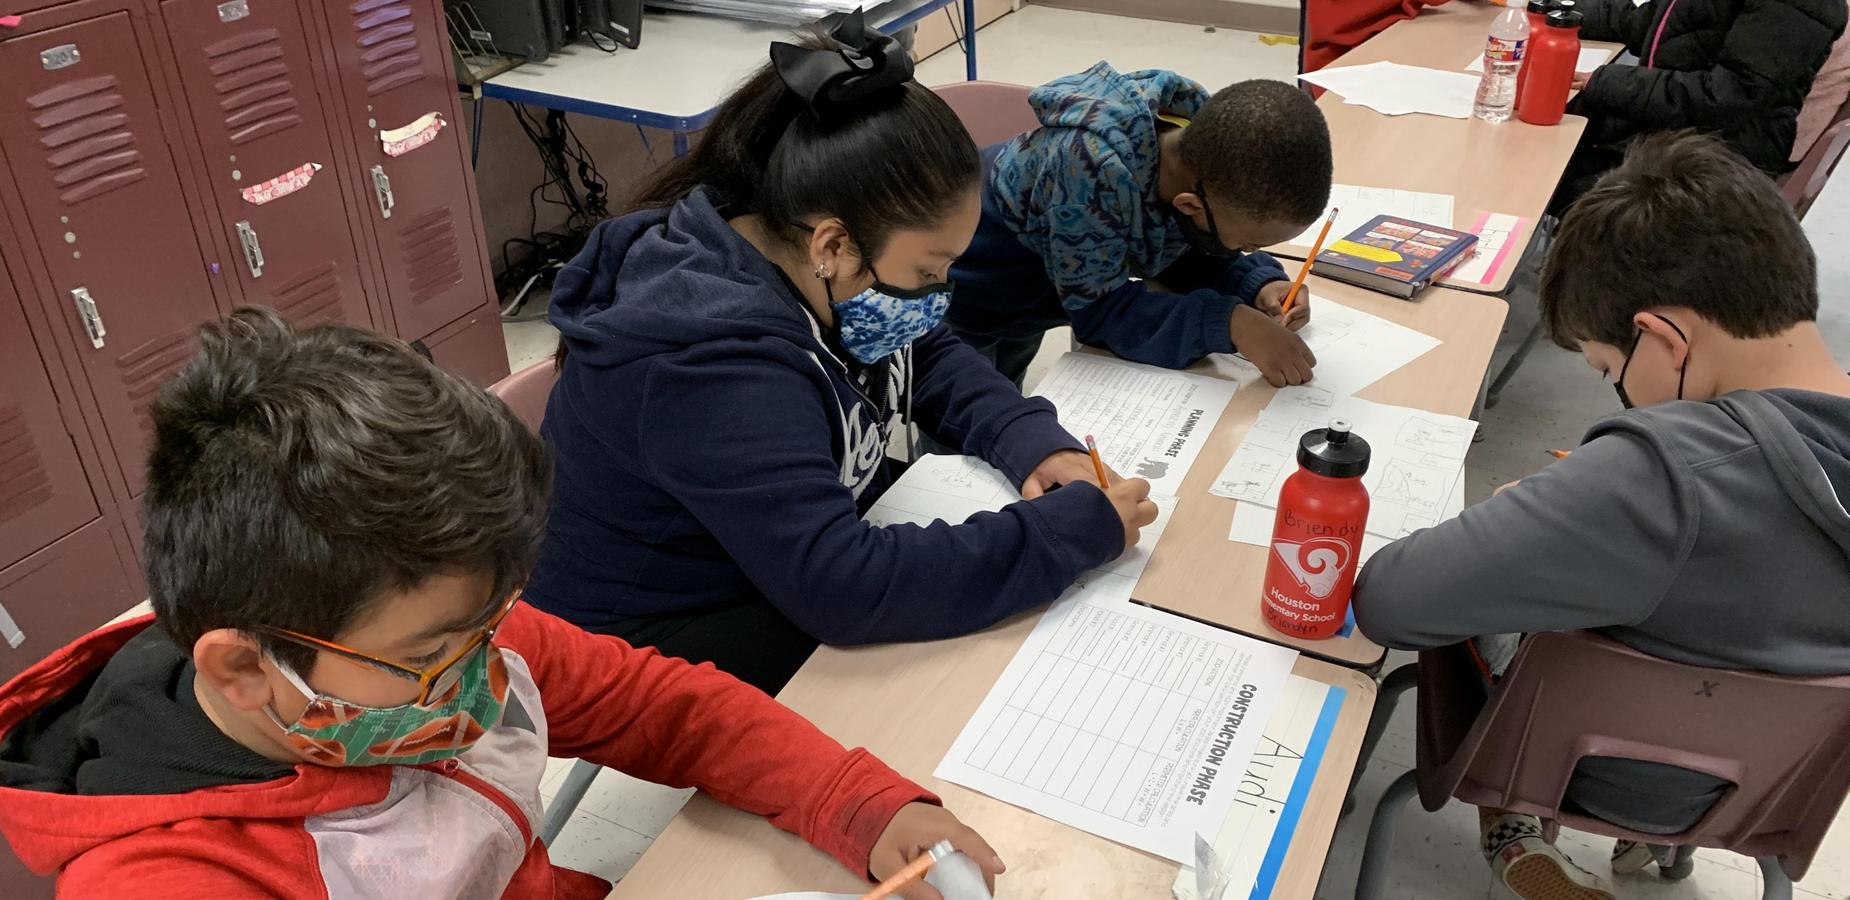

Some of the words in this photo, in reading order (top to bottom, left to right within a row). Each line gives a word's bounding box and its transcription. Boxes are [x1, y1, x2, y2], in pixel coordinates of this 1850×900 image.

[1178, 408, 1204, 437] PLANNING
[1165, 437, 1186, 458] PHASE
[1271, 586, 1320, 611] Houston
[1302, 611, 1336, 622] School
[1205, 683, 1257, 766] CONSTRUCTION
[1186, 766, 1217, 806] PHASE
